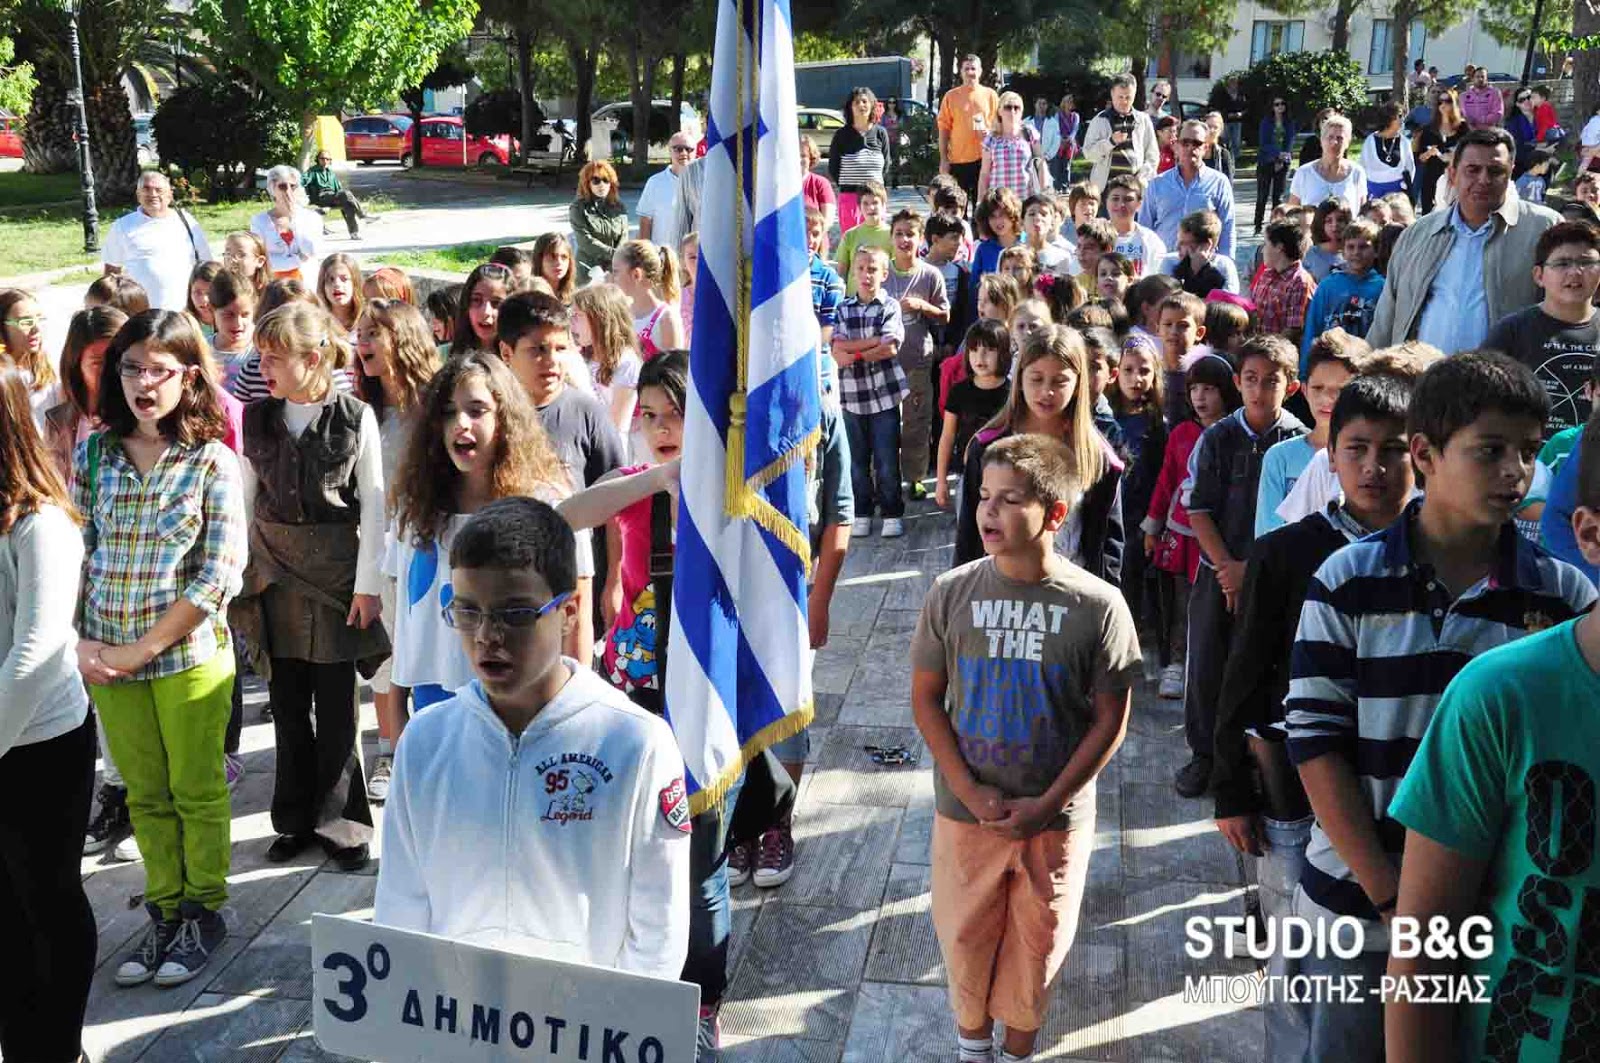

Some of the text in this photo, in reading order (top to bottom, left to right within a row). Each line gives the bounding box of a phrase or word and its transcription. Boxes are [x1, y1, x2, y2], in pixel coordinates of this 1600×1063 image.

[971, 599, 1069, 634] WHAT
[985, 629, 1045, 662] THE
[958, 708, 1031, 741] NOW
[535, 753, 613, 783] ALL AMERICAN
[545, 769, 570, 794] 95
[541, 799, 593, 826] Legend
[402, 989, 664, 1063] ΔΗΜΟΤΙΚΟ
